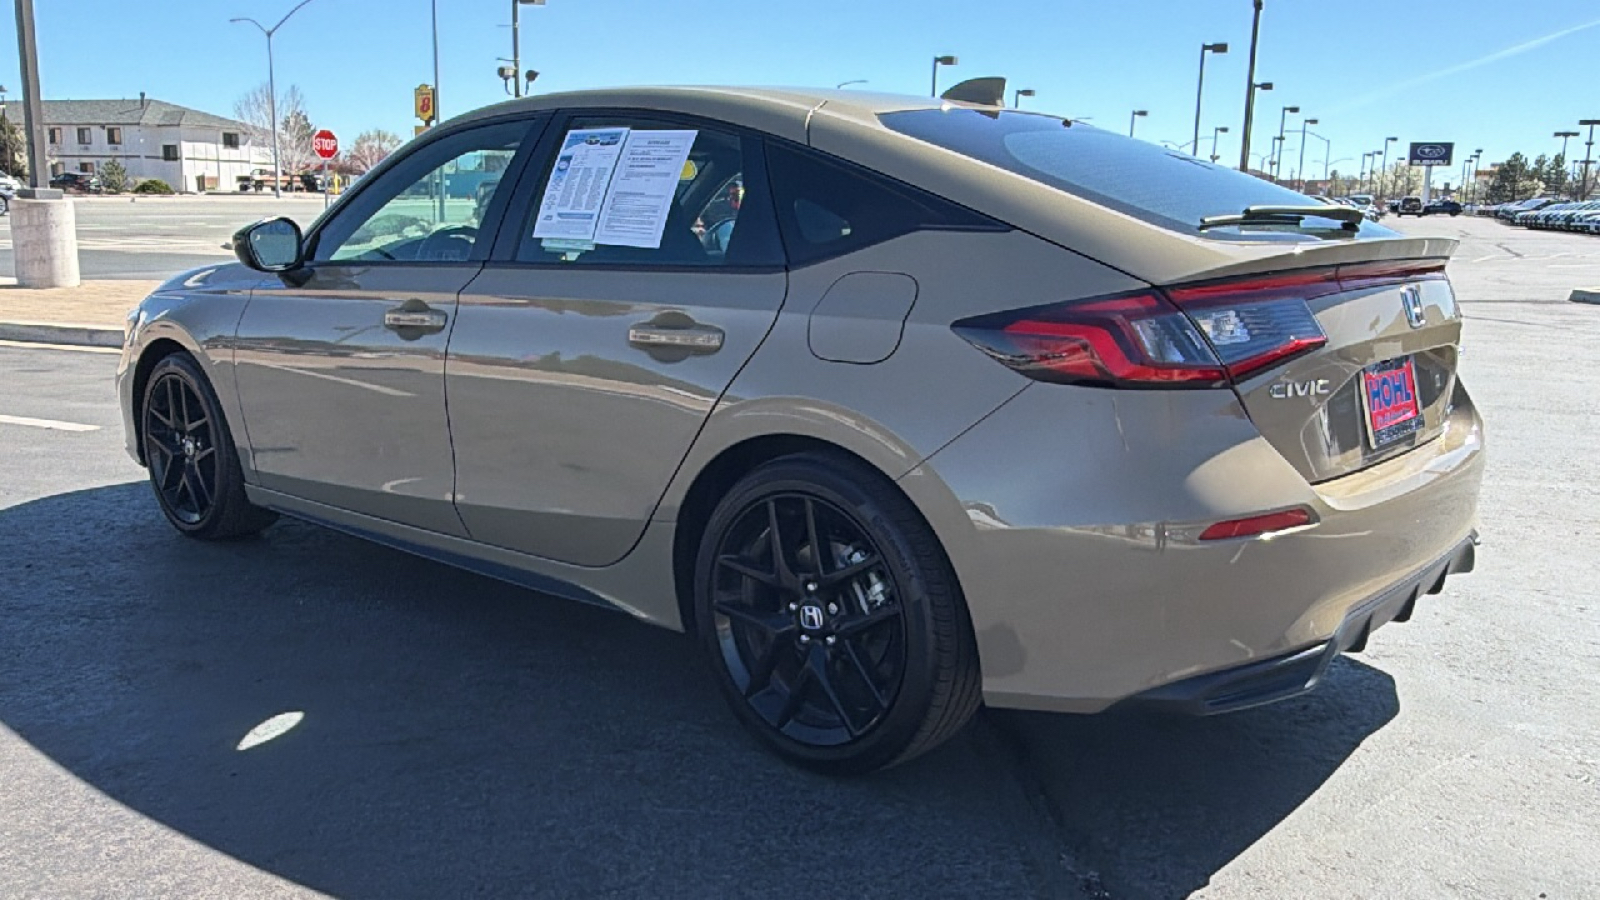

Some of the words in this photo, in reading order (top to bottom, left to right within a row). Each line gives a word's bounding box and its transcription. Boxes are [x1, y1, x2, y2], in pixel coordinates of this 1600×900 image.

[419, 96, 431, 113] 8
[315, 137, 336, 150] STOP
[1270, 380, 1330, 398] CIVIC
[1369, 372, 1412, 411] HOHL
